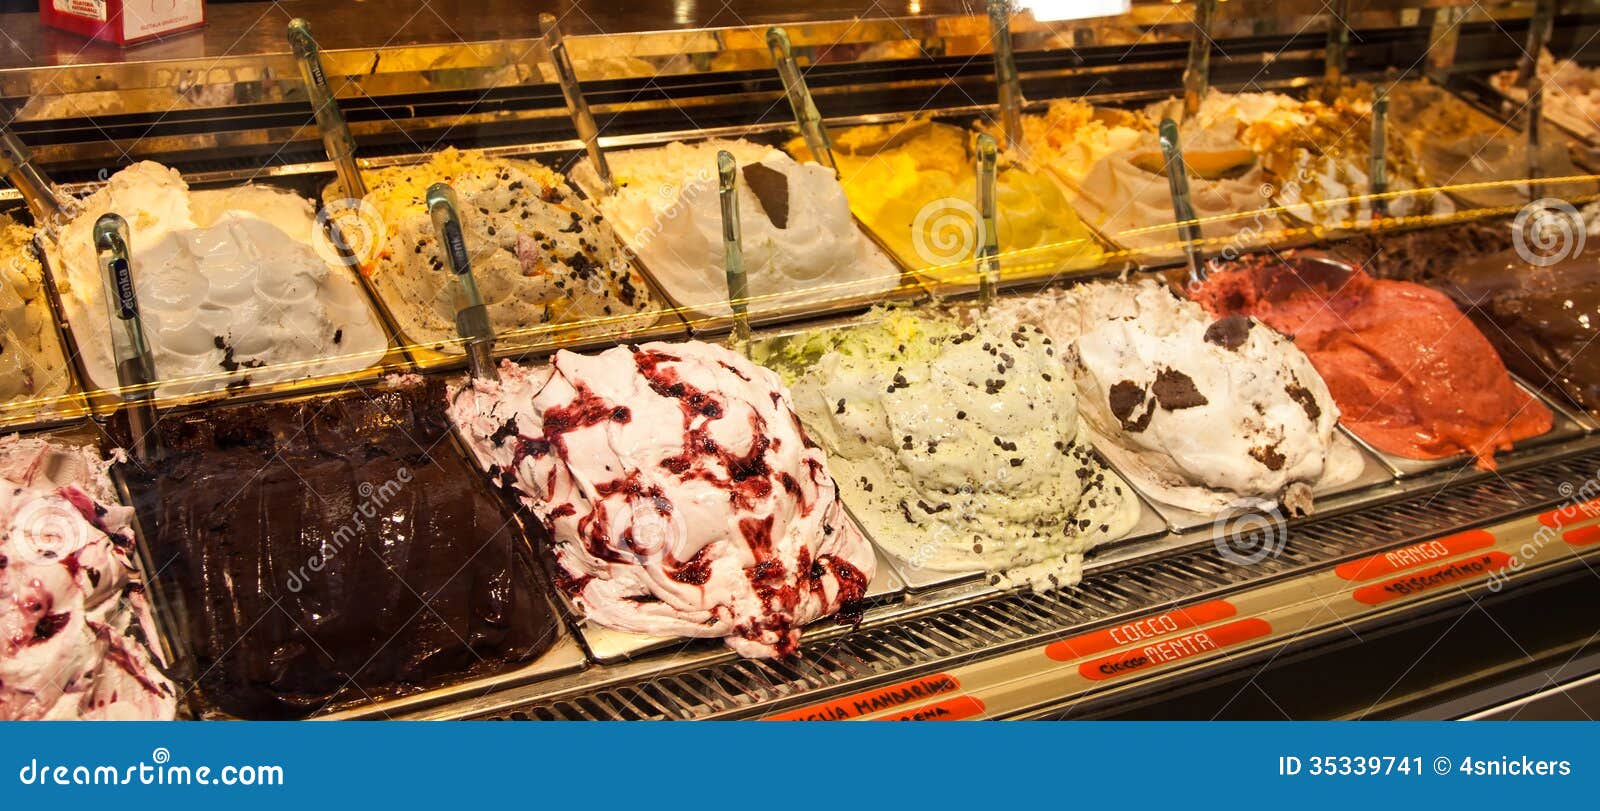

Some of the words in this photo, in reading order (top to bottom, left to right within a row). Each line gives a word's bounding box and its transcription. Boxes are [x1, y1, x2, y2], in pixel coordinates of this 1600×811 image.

[1384, 540, 1449, 568] MANGO
[1109, 615, 1178, 645] COCCO
[1143, 633, 1215, 665] MENTA
[853, 678, 956, 715] MANDARINO
